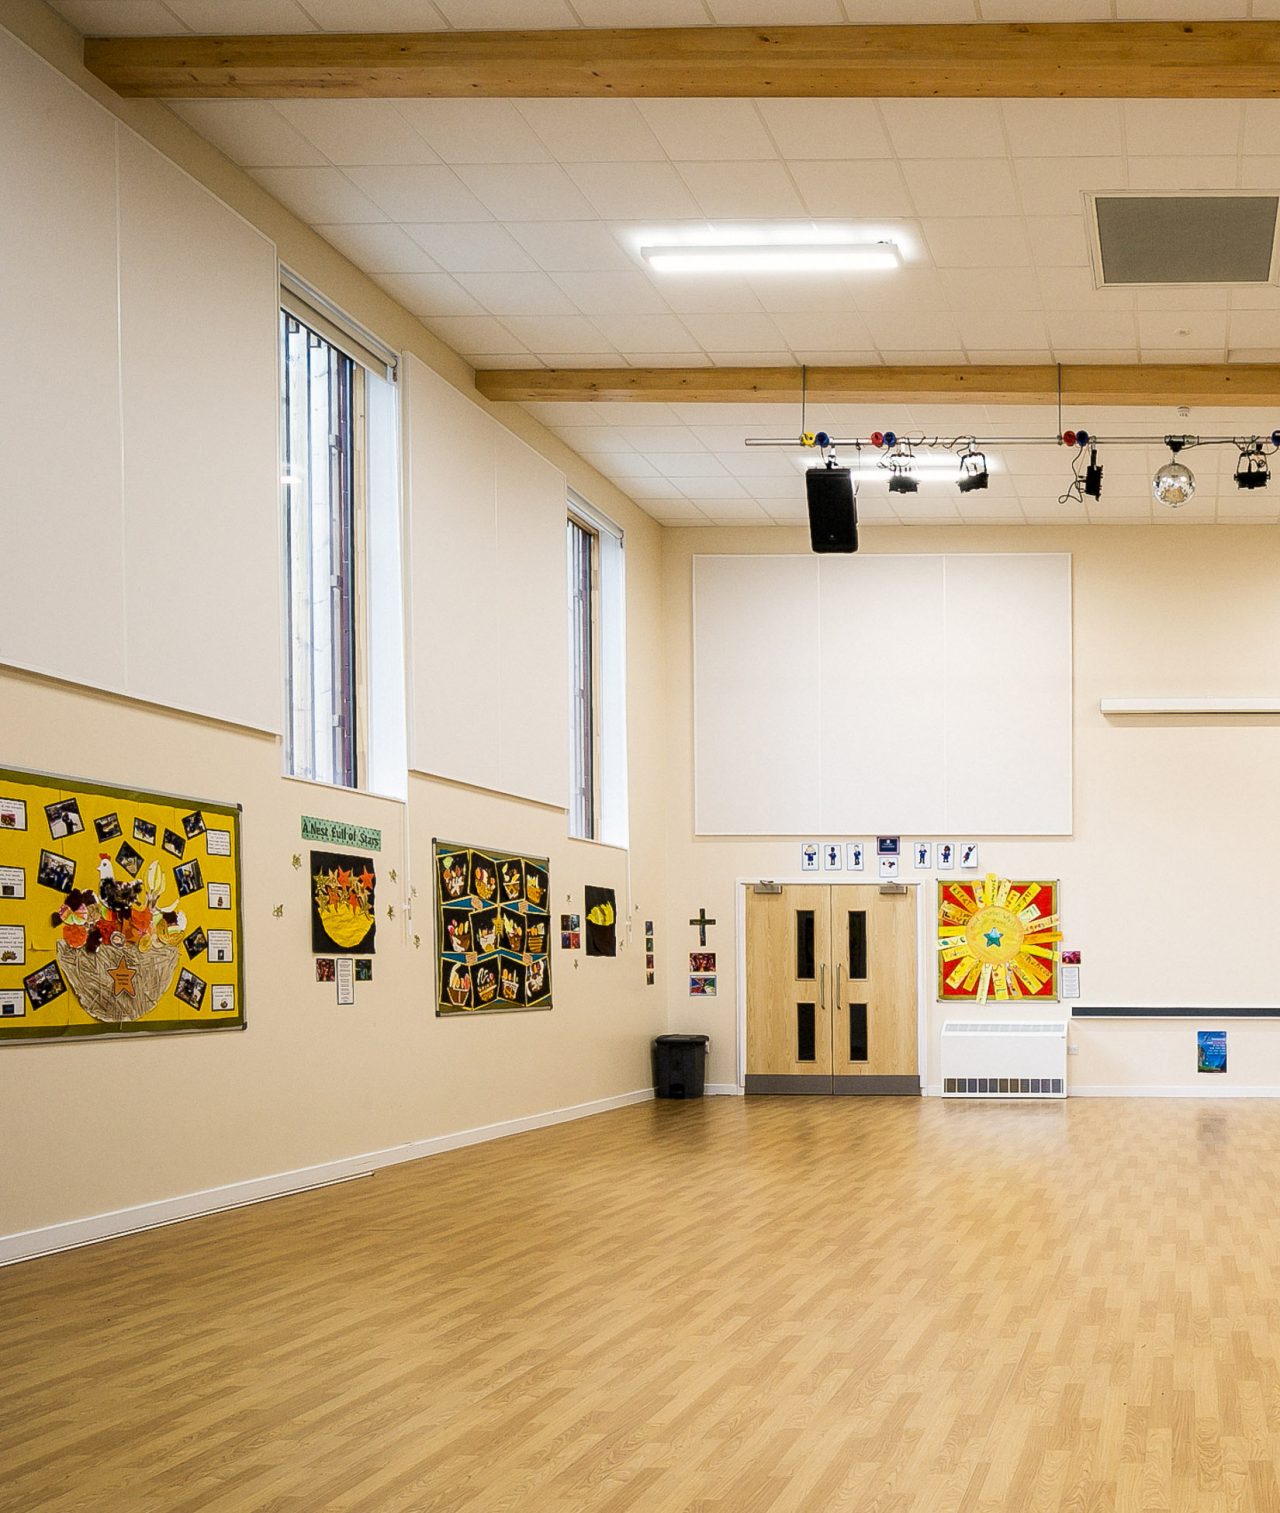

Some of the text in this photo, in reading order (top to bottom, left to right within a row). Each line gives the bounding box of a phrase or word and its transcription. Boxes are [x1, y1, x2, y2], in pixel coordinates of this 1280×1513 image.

[303, 821, 309, 834] A
[311, 822, 328, 837] Nest
[358, 832, 379, 847] Stars
